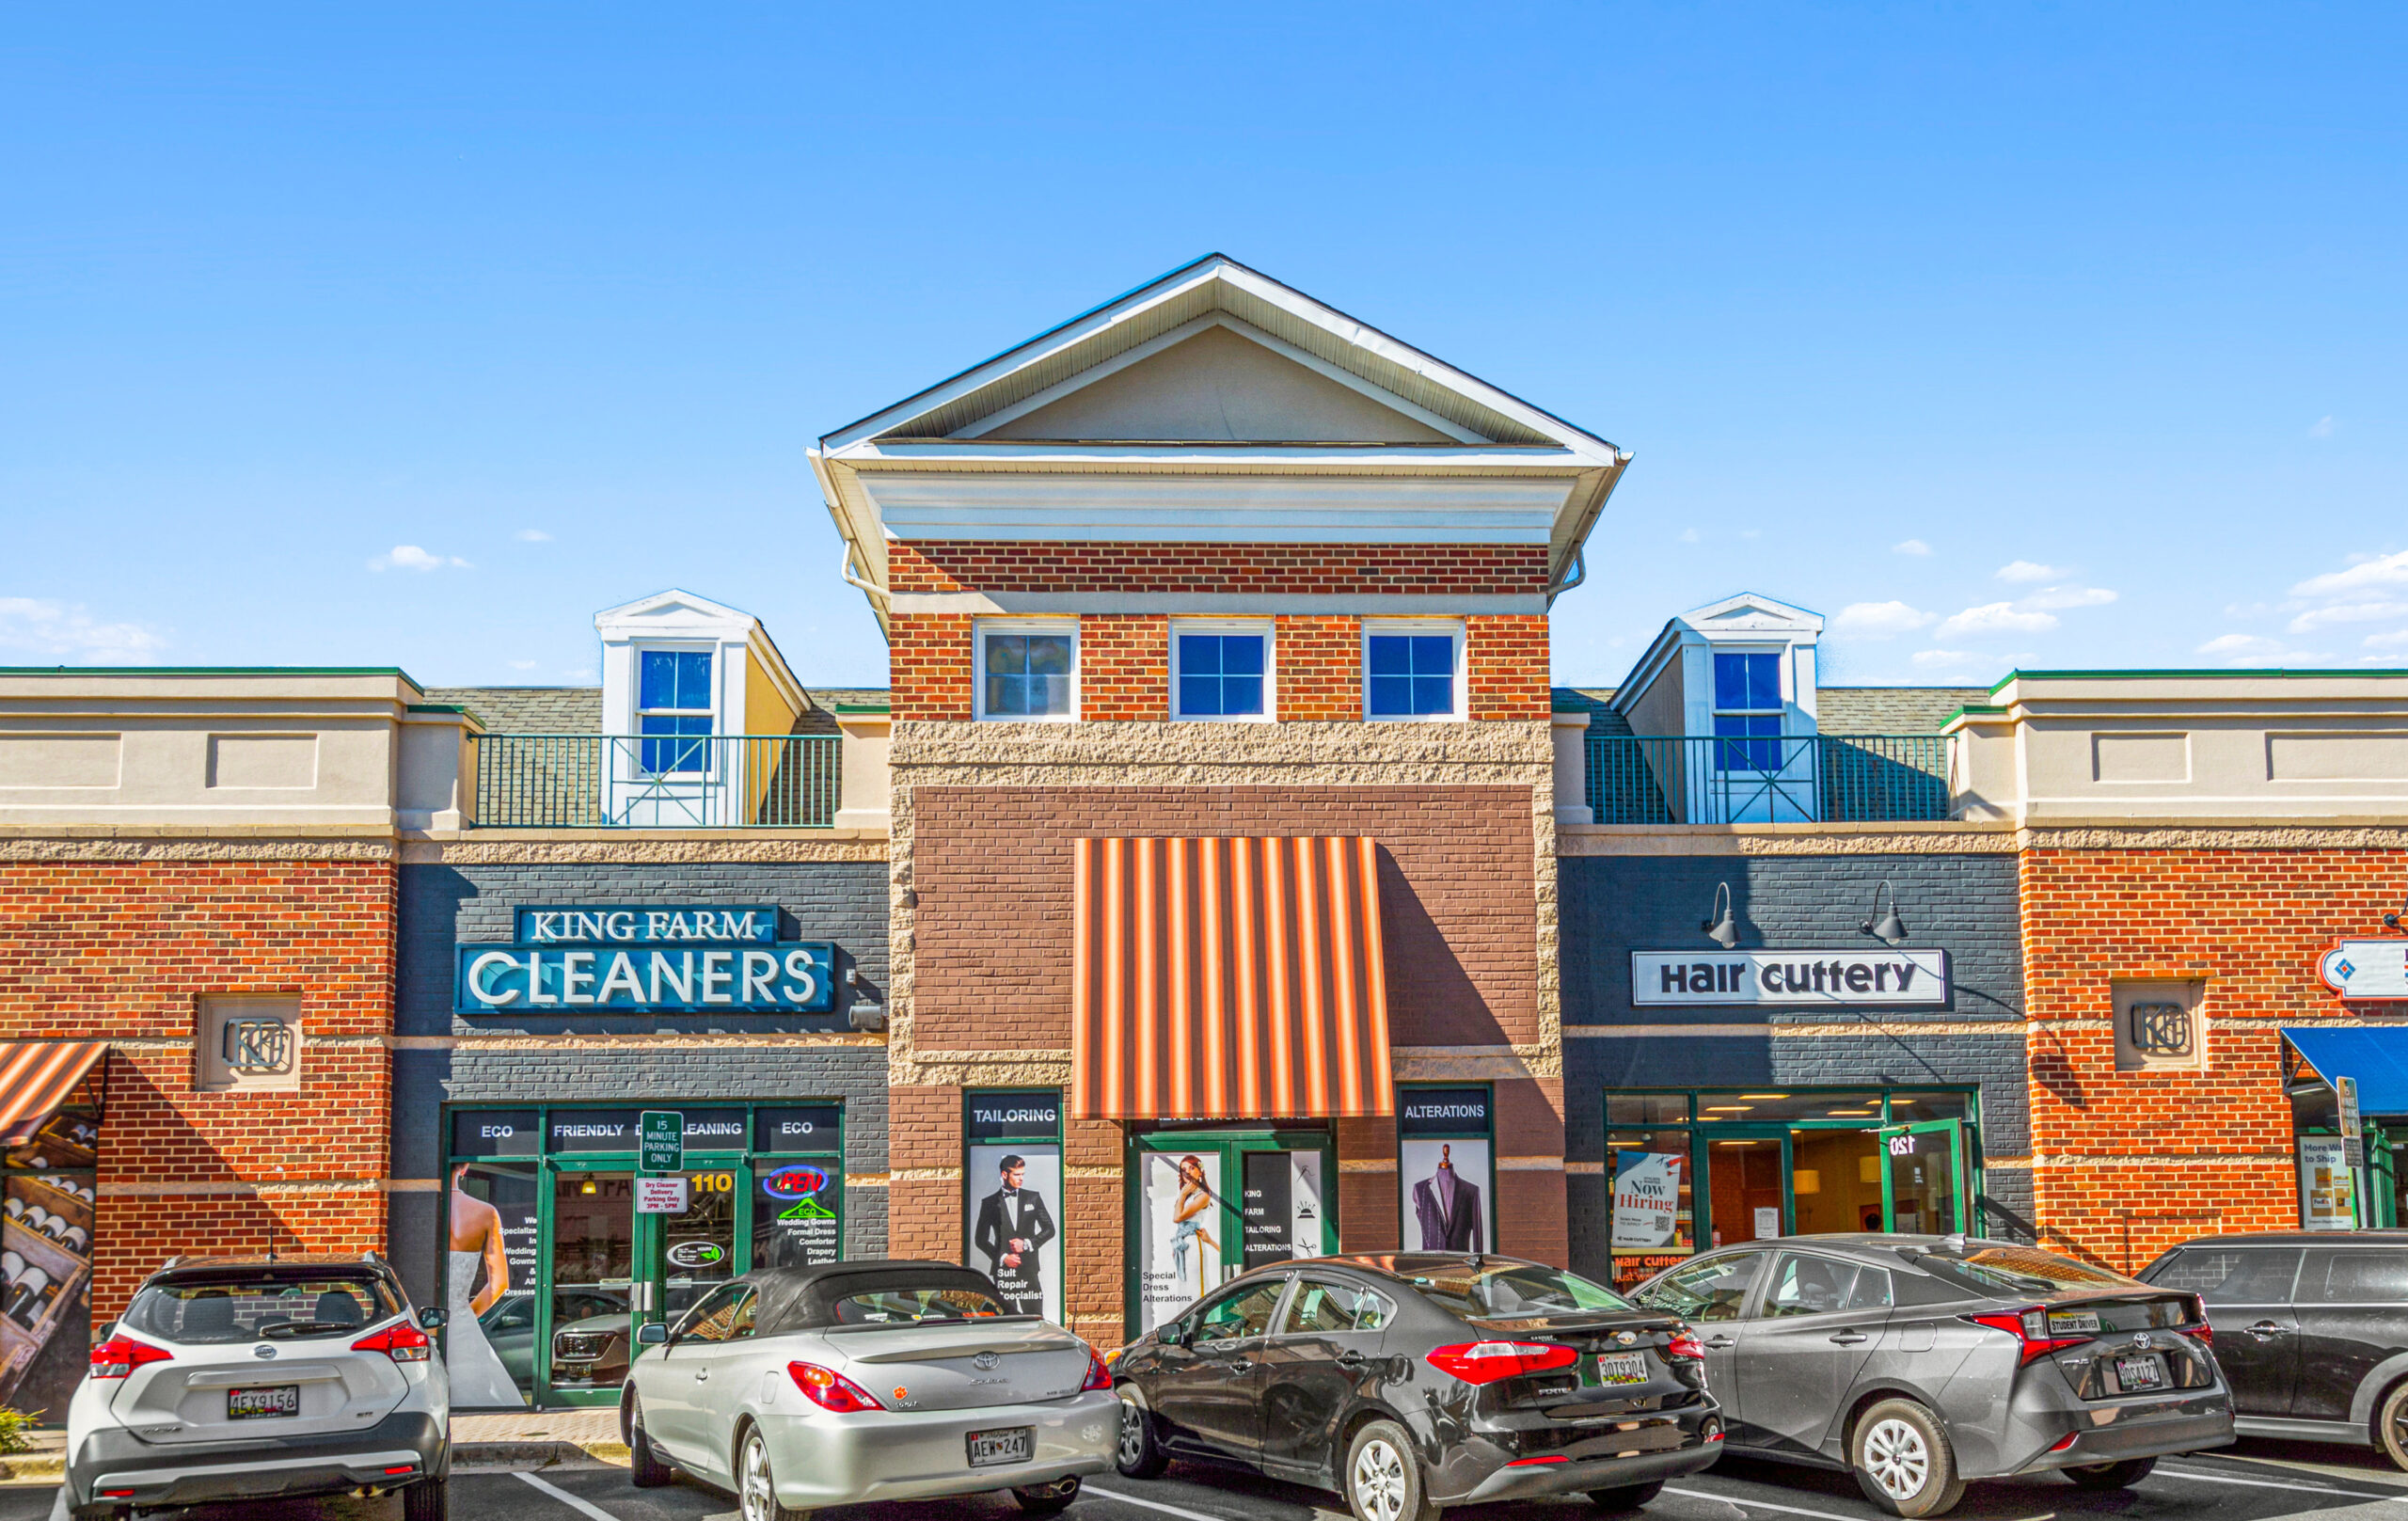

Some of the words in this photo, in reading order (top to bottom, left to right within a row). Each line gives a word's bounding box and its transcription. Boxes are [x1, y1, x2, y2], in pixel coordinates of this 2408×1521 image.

[532, 911, 636, 941] KING
[646, 911, 757, 940] FARM
[468, 950, 816, 1006] CLEANERS
[1661, 962, 1746, 994] Hair
[1761, 959, 1916, 994] cuttery
[974, 1108, 1056, 1123] TAILORING
[1404, 1104, 1485, 1118] ALTERATIONS
[657, 1120, 668, 1130] 15
[782, 1121, 813, 1134] ECO
[481, 1125, 514, 1138] ECO
[553, 1124, 625, 1137] FRIENDLY
[646, 1132, 677, 1141] MINUTE
[643, 1142, 679, 1152] PARKING
[2305, 1144, 2327, 1152] More
[651, 1153, 673, 1164] ONLY
[2305, 1155, 2314, 1164] to
[2315, 1155, 2337, 1165] Ship
[691, 1173, 733, 1193] 110
[768, 1173, 823, 1193] OPEN
[1631, 1180, 1666, 1196] Now
[1619, 1194, 1674, 1215] Hiring
[1244, 1208, 1265, 1216] FARM
[524, 1216, 538, 1225] We
[777, 1218, 810, 1228] Wedding
[499, 1228, 537, 1236] Specialize
[787, 1228, 813, 1236] Formal
[1244, 1226, 1282, 1234] TAILORING
[503, 1247, 537, 1257] Wedding
[806, 1247, 836, 1257] Drapery
[1244, 1244, 1292, 1252] ALTERATIONS
[997, 1269, 1017, 1278] Suit
[1142, 1272, 1177, 1281] Special
[524, 1277, 536, 1286] All
[997, 1279, 1029, 1291] Repair
[1142, 1283, 1169, 1291] Dress
[999, 1291, 1044, 1301] pecialist
[1142, 1294, 1193, 1304] Alterations
[2052, 1319, 2078, 1331] STUDENT
[2078, 1318, 2099, 1329] DRIVER
[1602, 1359, 1644, 1378] 3DT9304
[231, 1393, 295, 1412] 4EX9156
[1005, 1436, 1026, 1454] 247
